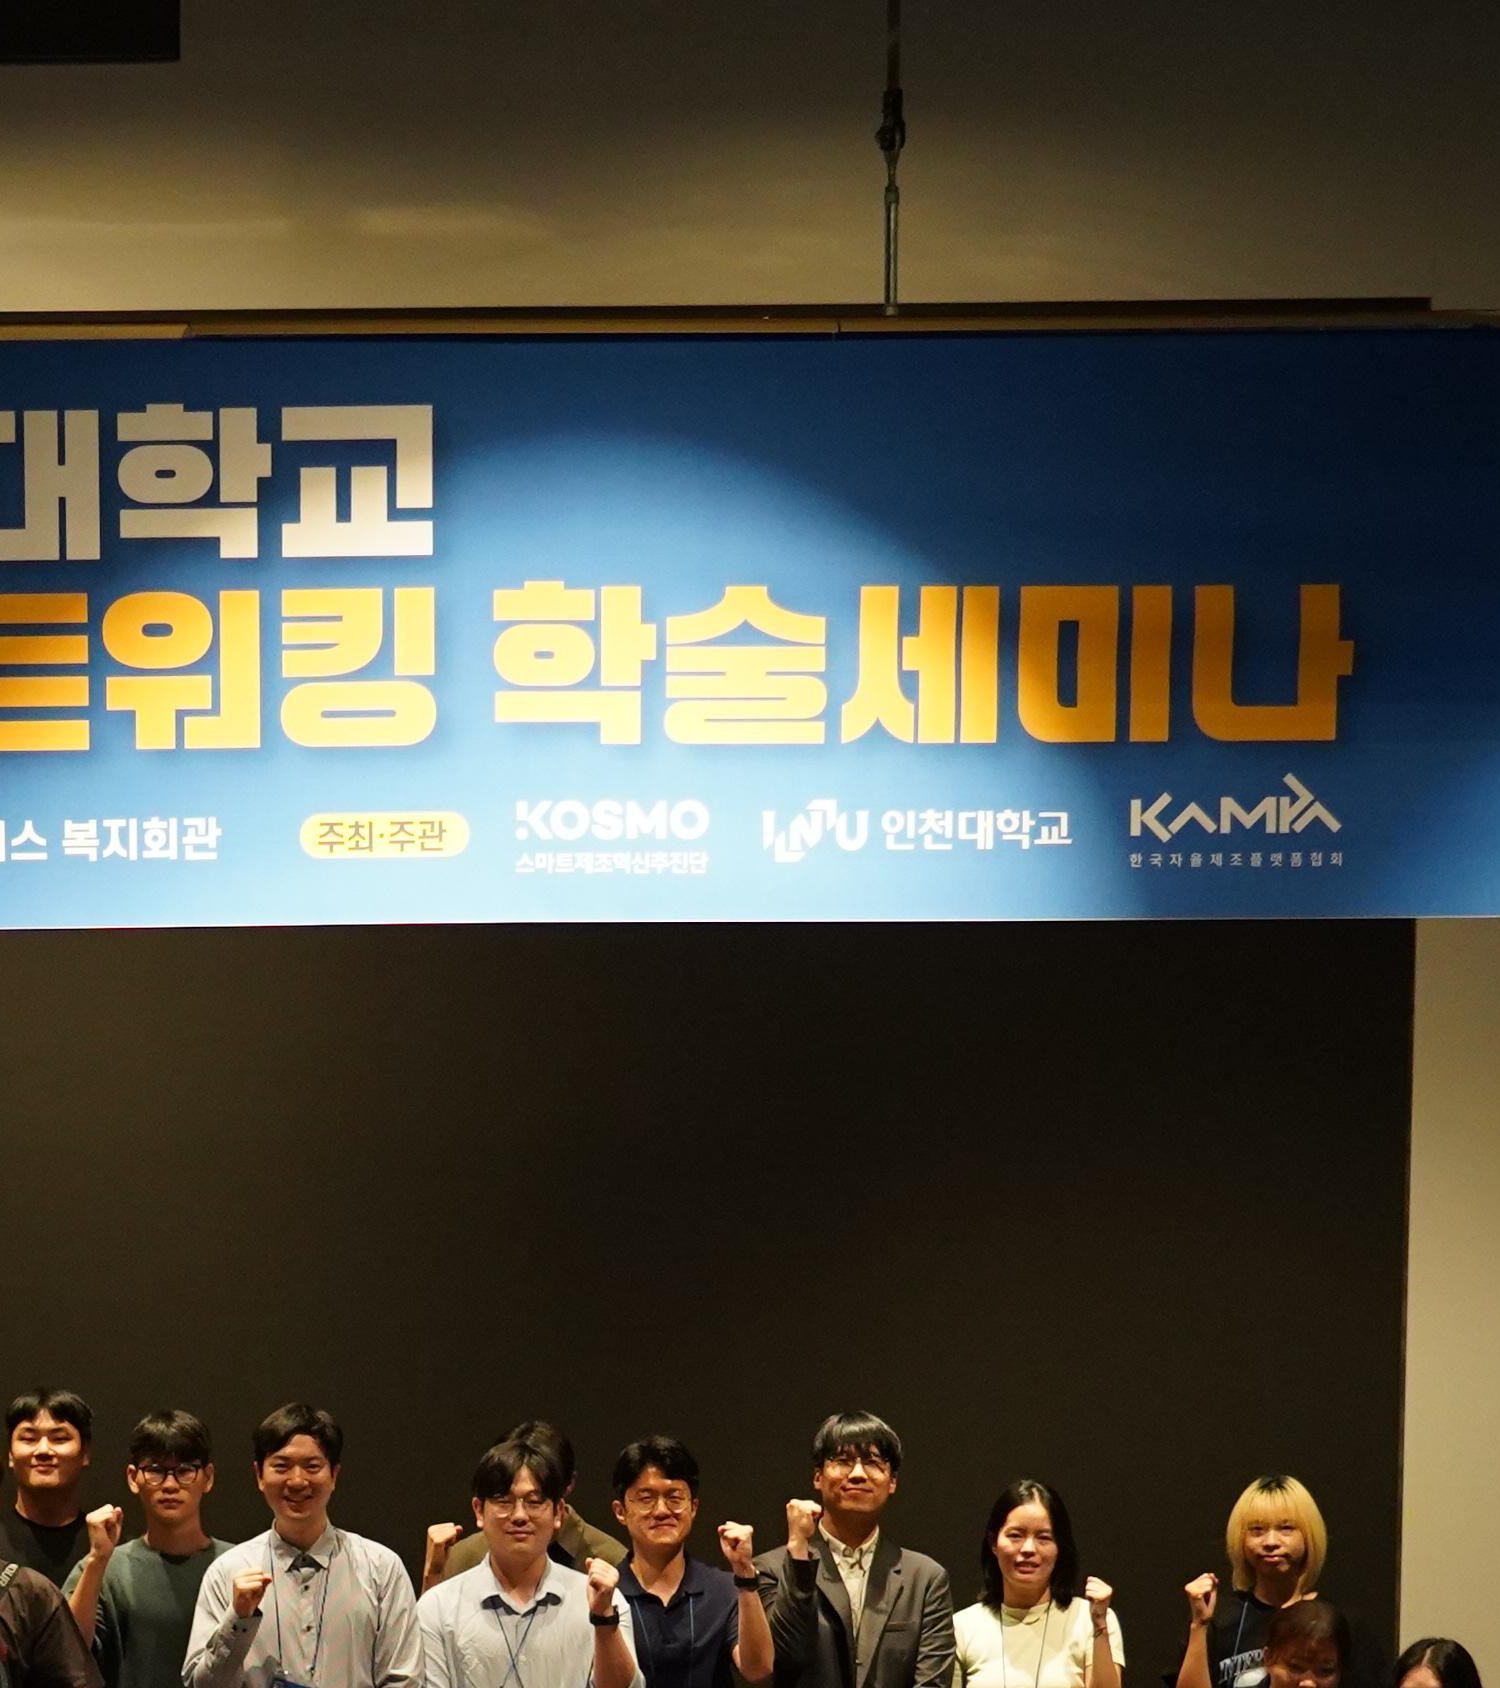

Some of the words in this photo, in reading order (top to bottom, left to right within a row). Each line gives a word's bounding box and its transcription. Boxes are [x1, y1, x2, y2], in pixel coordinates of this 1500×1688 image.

[492, 581, 1355, 745] 학술세미나
[60, 816, 222, 862] 복지회관
[515, 799, 710, 841] KOSMO
[881, 808, 1073, 852] 인천대학교
